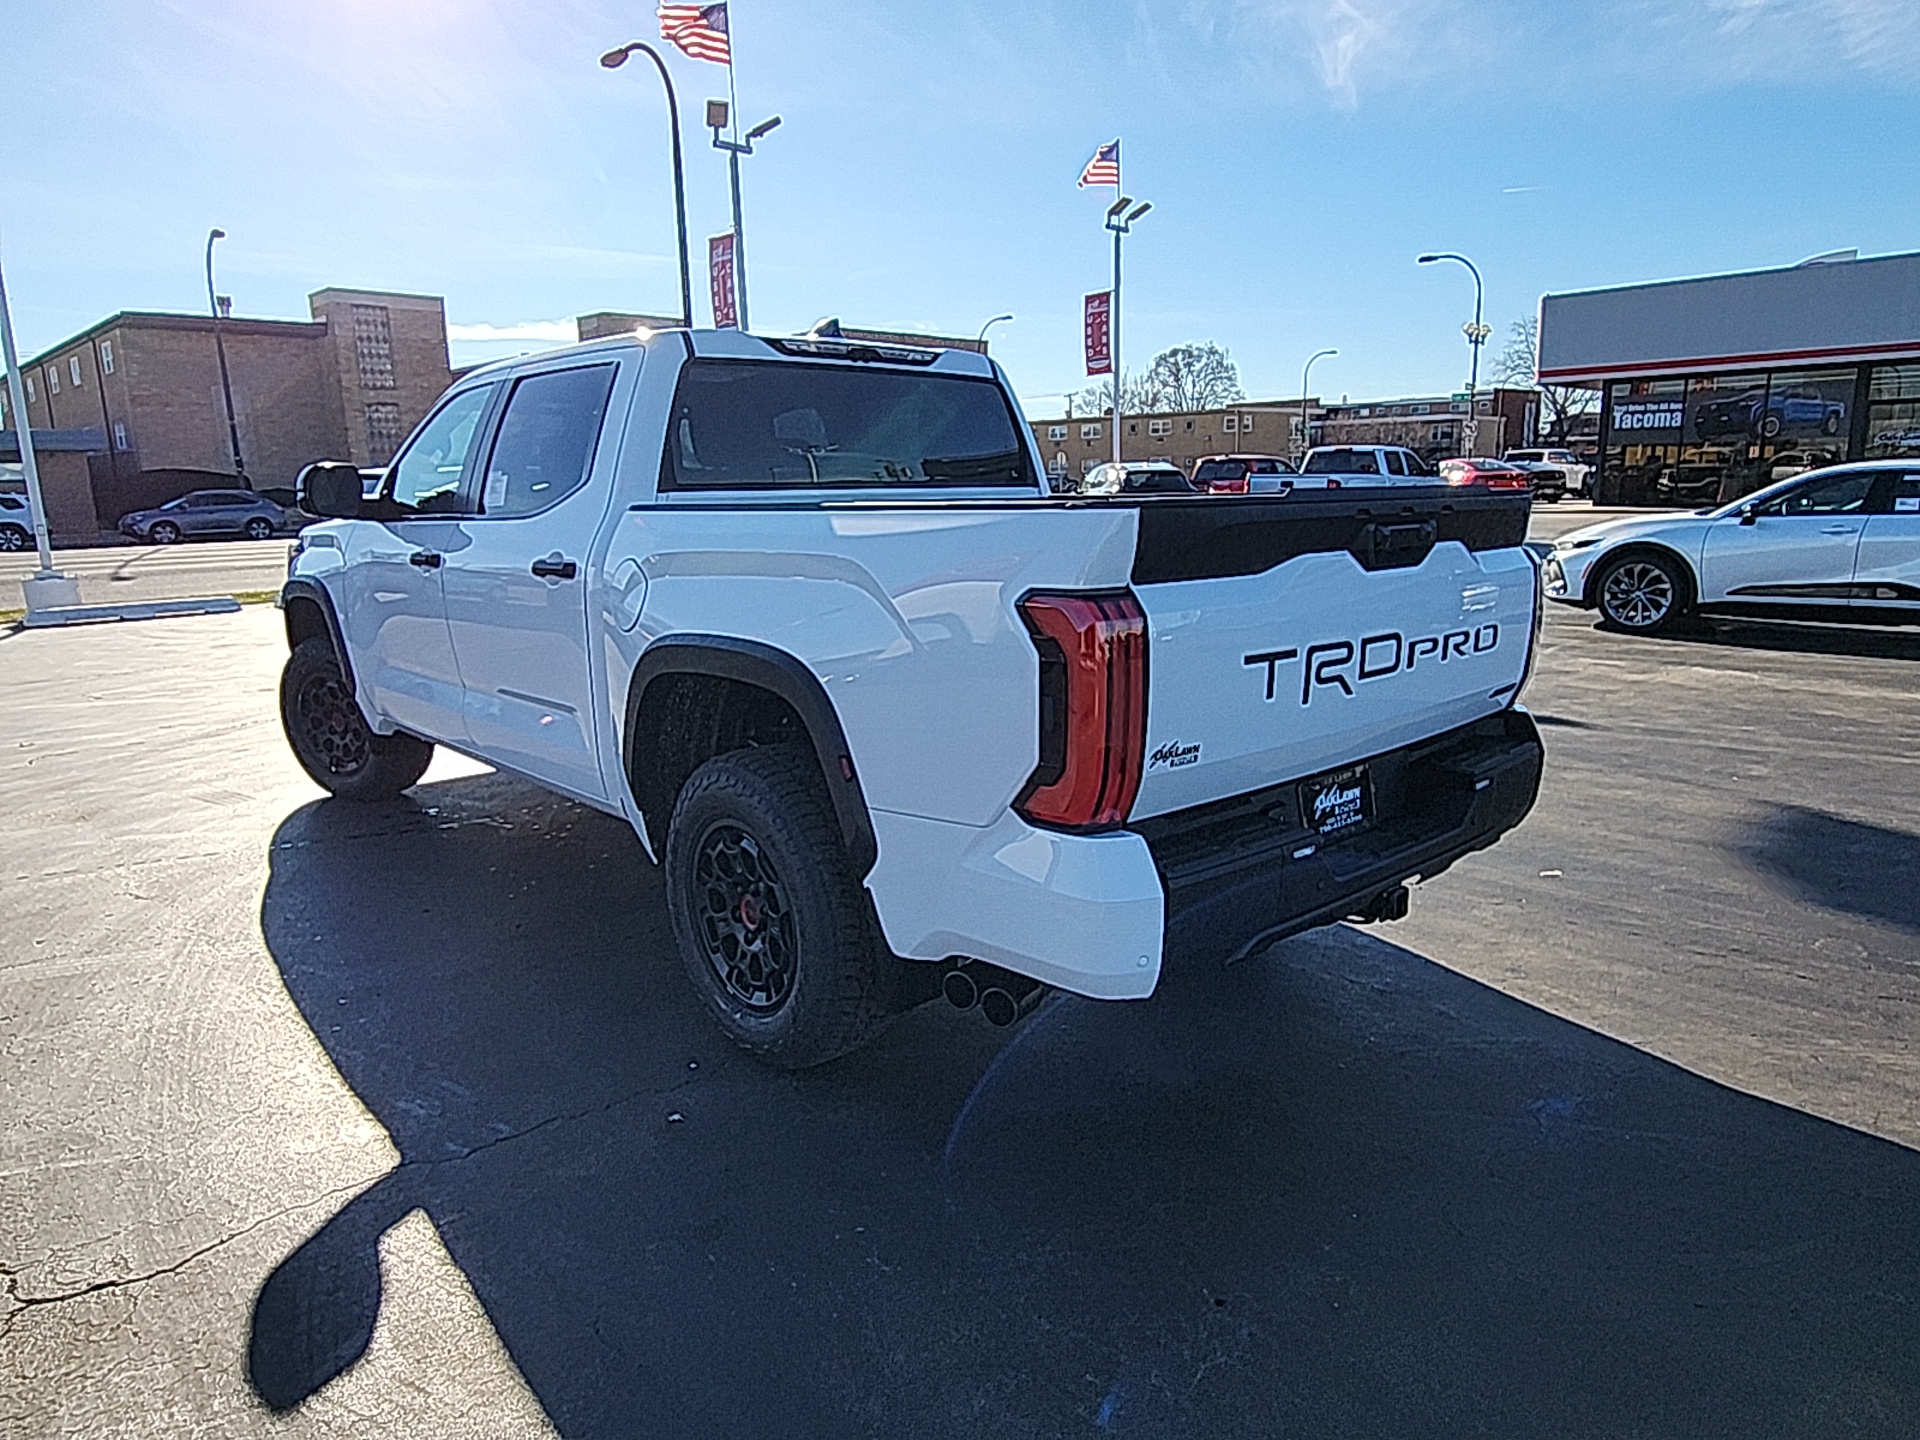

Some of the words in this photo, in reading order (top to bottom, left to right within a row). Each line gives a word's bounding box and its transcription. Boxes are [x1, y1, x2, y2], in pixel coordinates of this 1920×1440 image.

[1613, 411, 1683, 430] Tacoma
[1243, 631, 1403, 706] TRD
[1405, 623, 1499, 669] PRO
